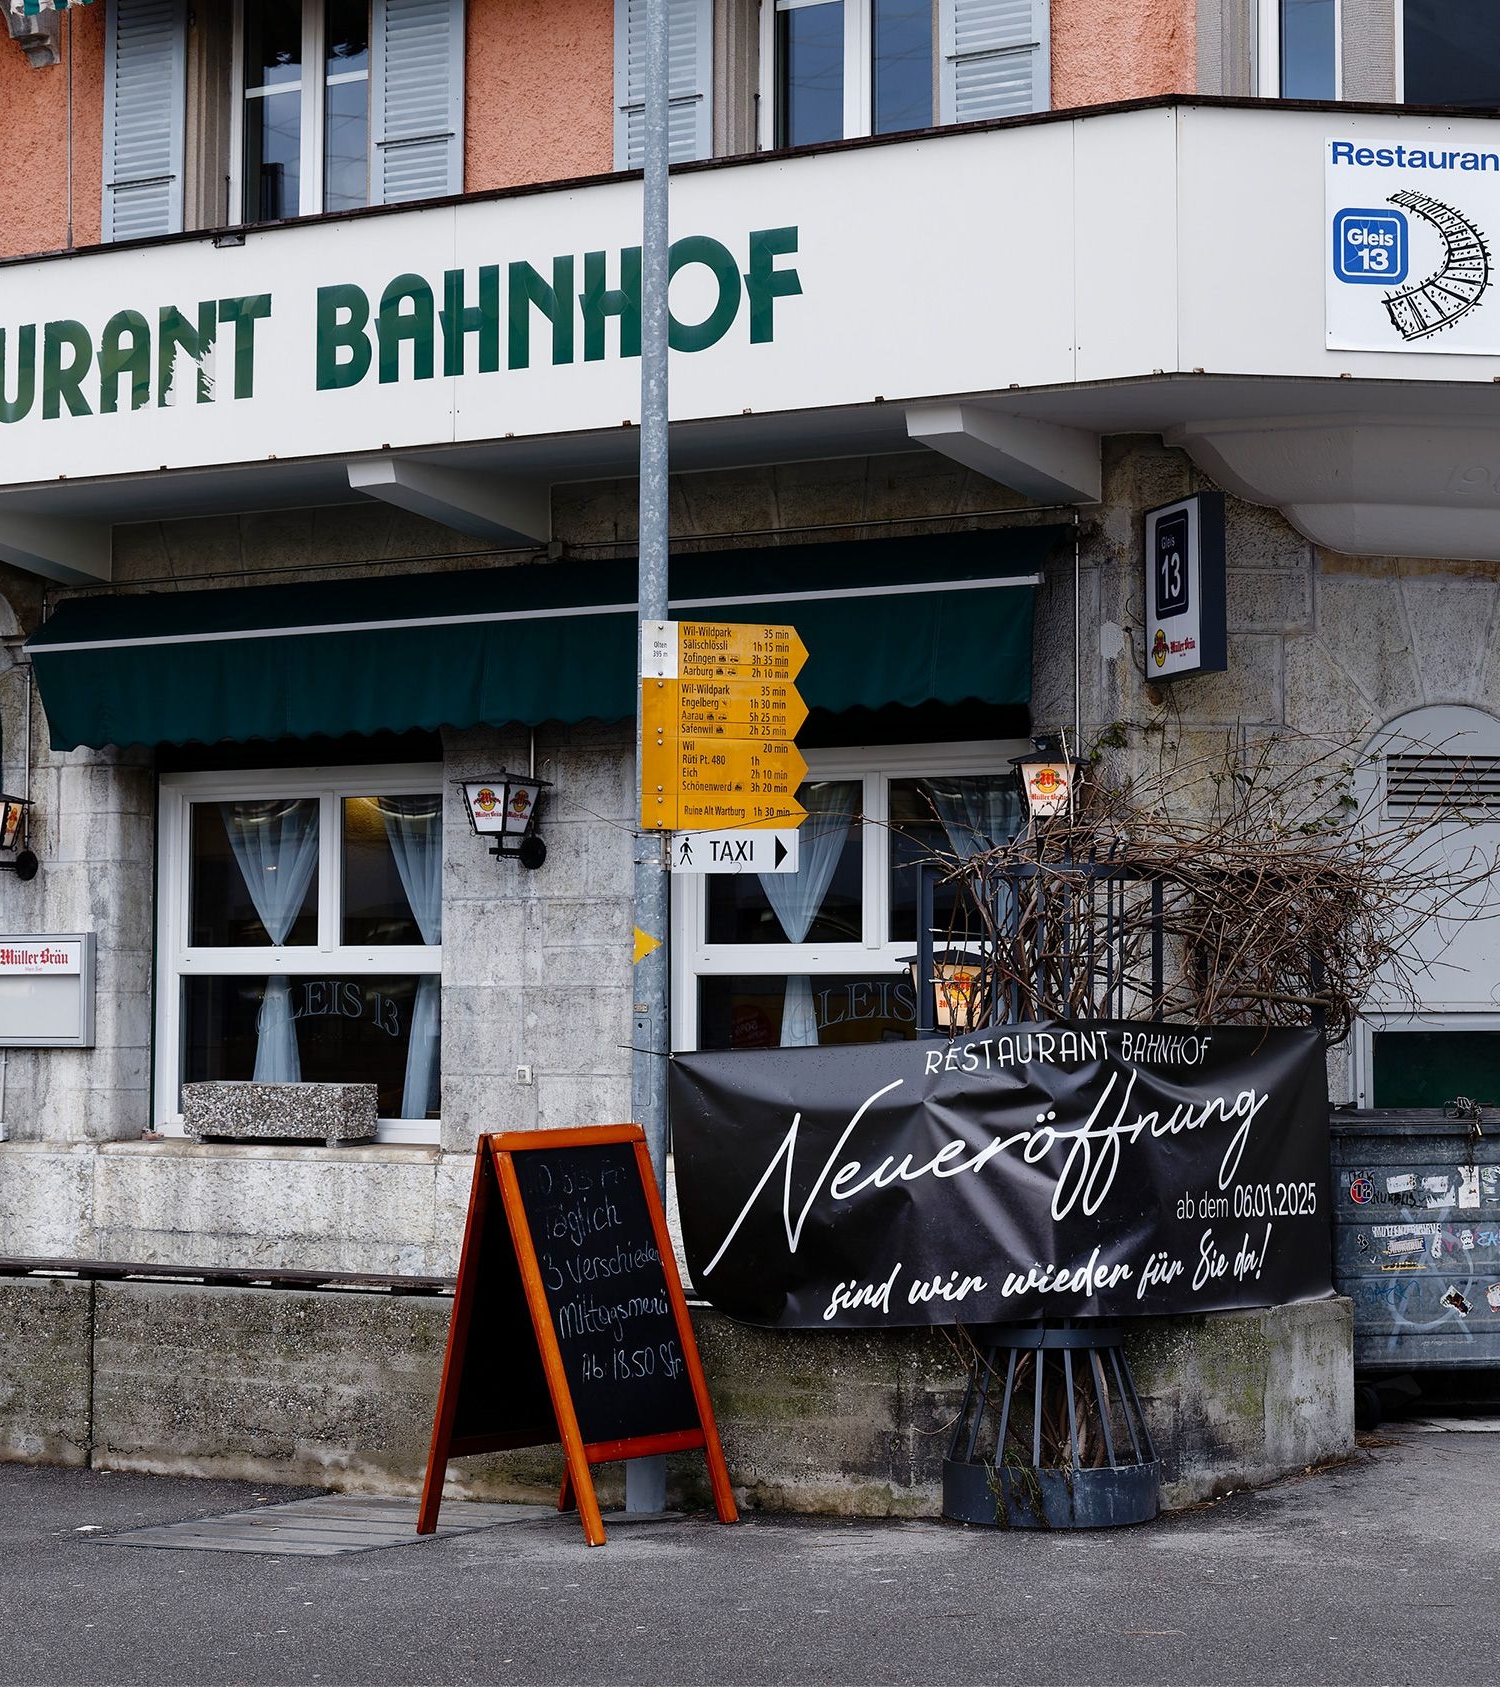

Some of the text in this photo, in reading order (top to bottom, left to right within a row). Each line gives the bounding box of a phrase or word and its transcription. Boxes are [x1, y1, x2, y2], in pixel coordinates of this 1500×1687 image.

[1332, 141, 1500, 172] Restauran
[1347, 228, 1394, 247] Gleis
[1358, 248, 1389, 270] 13
[315, 225, 803, 391] BAHNHOF
[1161, 552, 1181, 599] 13
[683, 626, 732, 639] Wil-Wildpark
[764, 629, 773, 638] 35
[754, 642, 762, 651] 1h
[765, 643, 773, 652] 15
[683, 653, 716, 665] Zofingen
[752, 655, 761, 665] 3h
[764, 656, 772, 665] 35
[683, 666, 713, 678] Aarburg
[752, 668, 761, 677] 2h
[764, 669, 772, 678] 10
[682, 684, 786, 696] Wil-Wildpark 35 min
[682, 697, 786, 710] Engelberg 1h 30 min
[682, 710, 786, 722] Aarau 5h 25 min
[750, 726, 758, 735] 2h
[762, 726, 770, 735] 25
[773, 726, 786, 735] min
[683, 741, 788, 753] Wil 20 min
[683, 754, 759, 766] Rüti Pt. 480 1h
[683, 768, 787, 779] Eich 2h 10 min
[682, 781, 787, 792] Schönenwerd 3h 20 min
[684, 806, 790, 818] Ruine Alt Wartburg 1h 30 min
[709, 840, 754, 862] TAXI
[0, 947, 68, 965] Müller Bräu
[372, 991, 400, 1037] 13
[924, 1031, 1211, 1076] RESTAURANT BAHNHOF
[703, 1067, 1269, 1276] Neueröffnung
[1177, 1182, 1317, 1219] ab dem 06.01.2025
[543, 1252, 563, 1290] 3
[823, 1222, 1273, 1321] sind wir wieder für Sie da!
